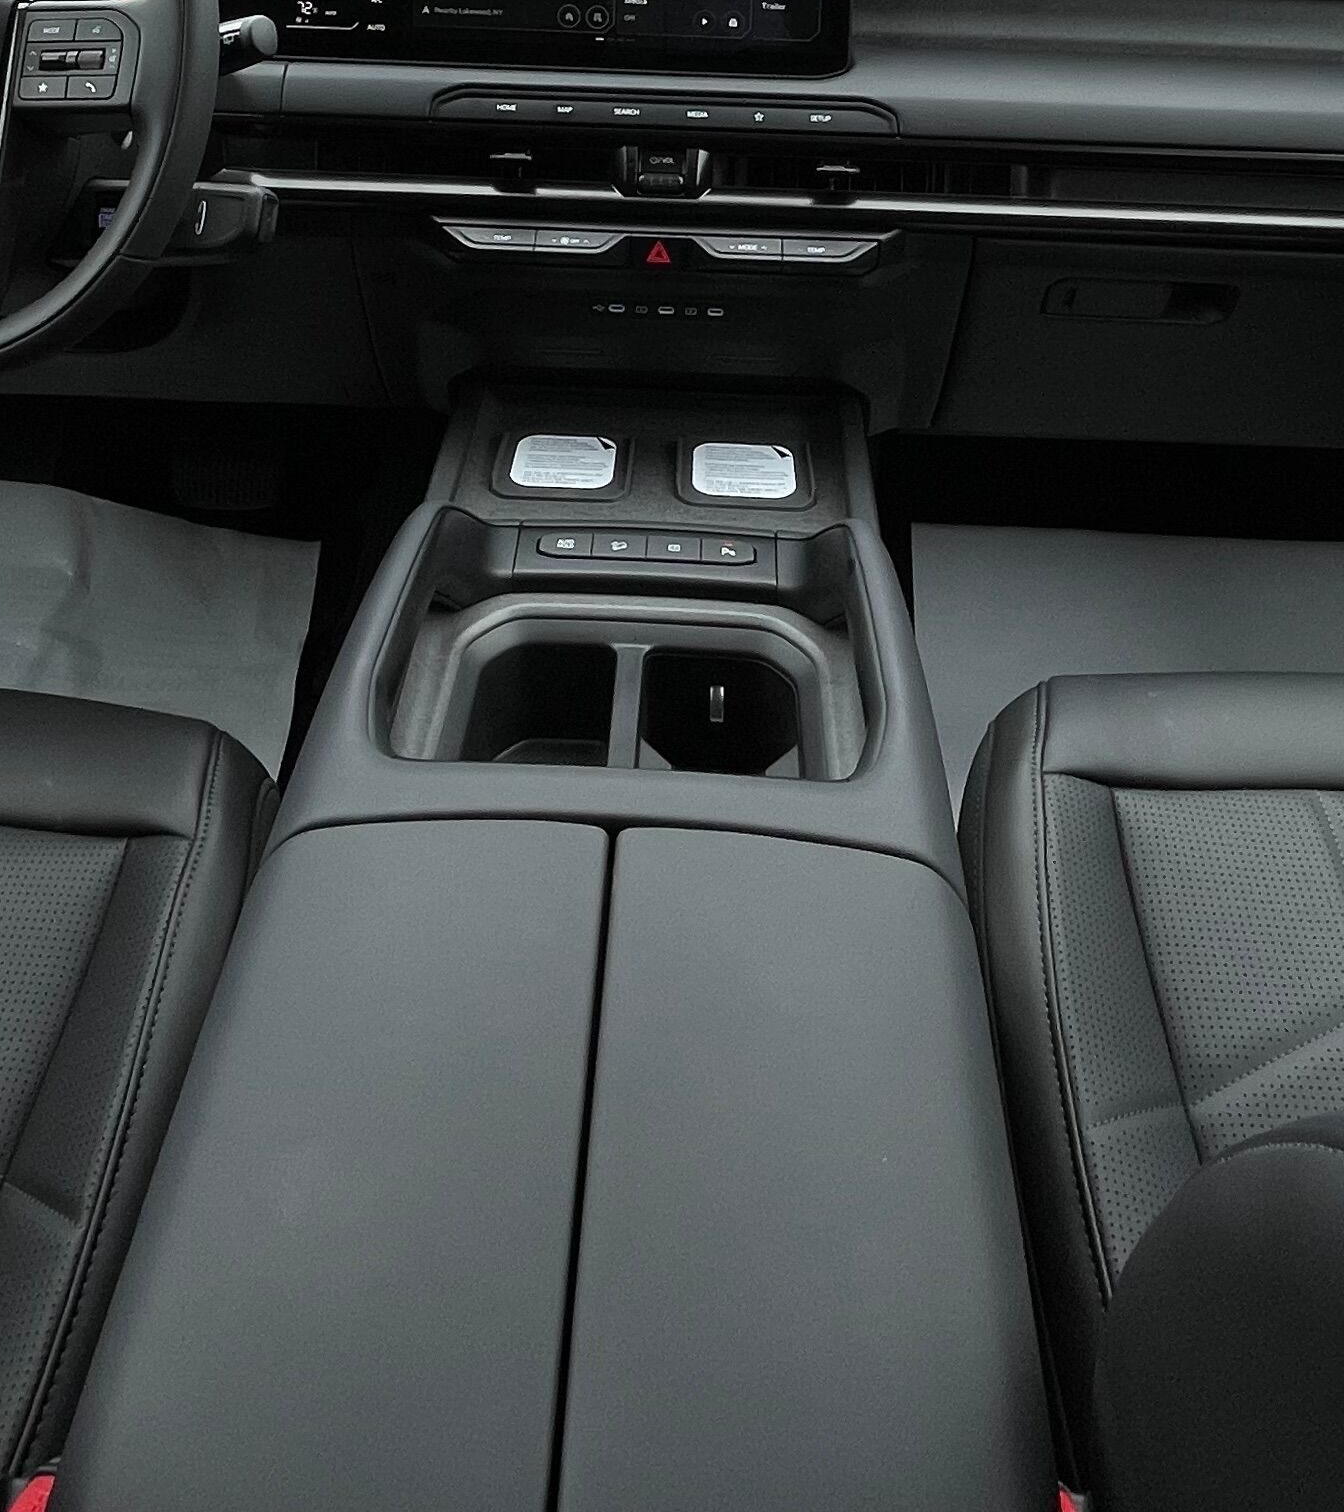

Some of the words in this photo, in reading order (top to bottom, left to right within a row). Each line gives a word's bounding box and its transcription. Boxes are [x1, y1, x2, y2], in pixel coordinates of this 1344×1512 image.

[366, 23, 386, 32] AUTO
[495, 102, 518, 112] HOME
[556, 105, 574, 114] MAP
[612, 106, 641, 117] SEARCH
[686, 109, 709, 120] MEDIA
[809, 113, 832, 123] SETUP
